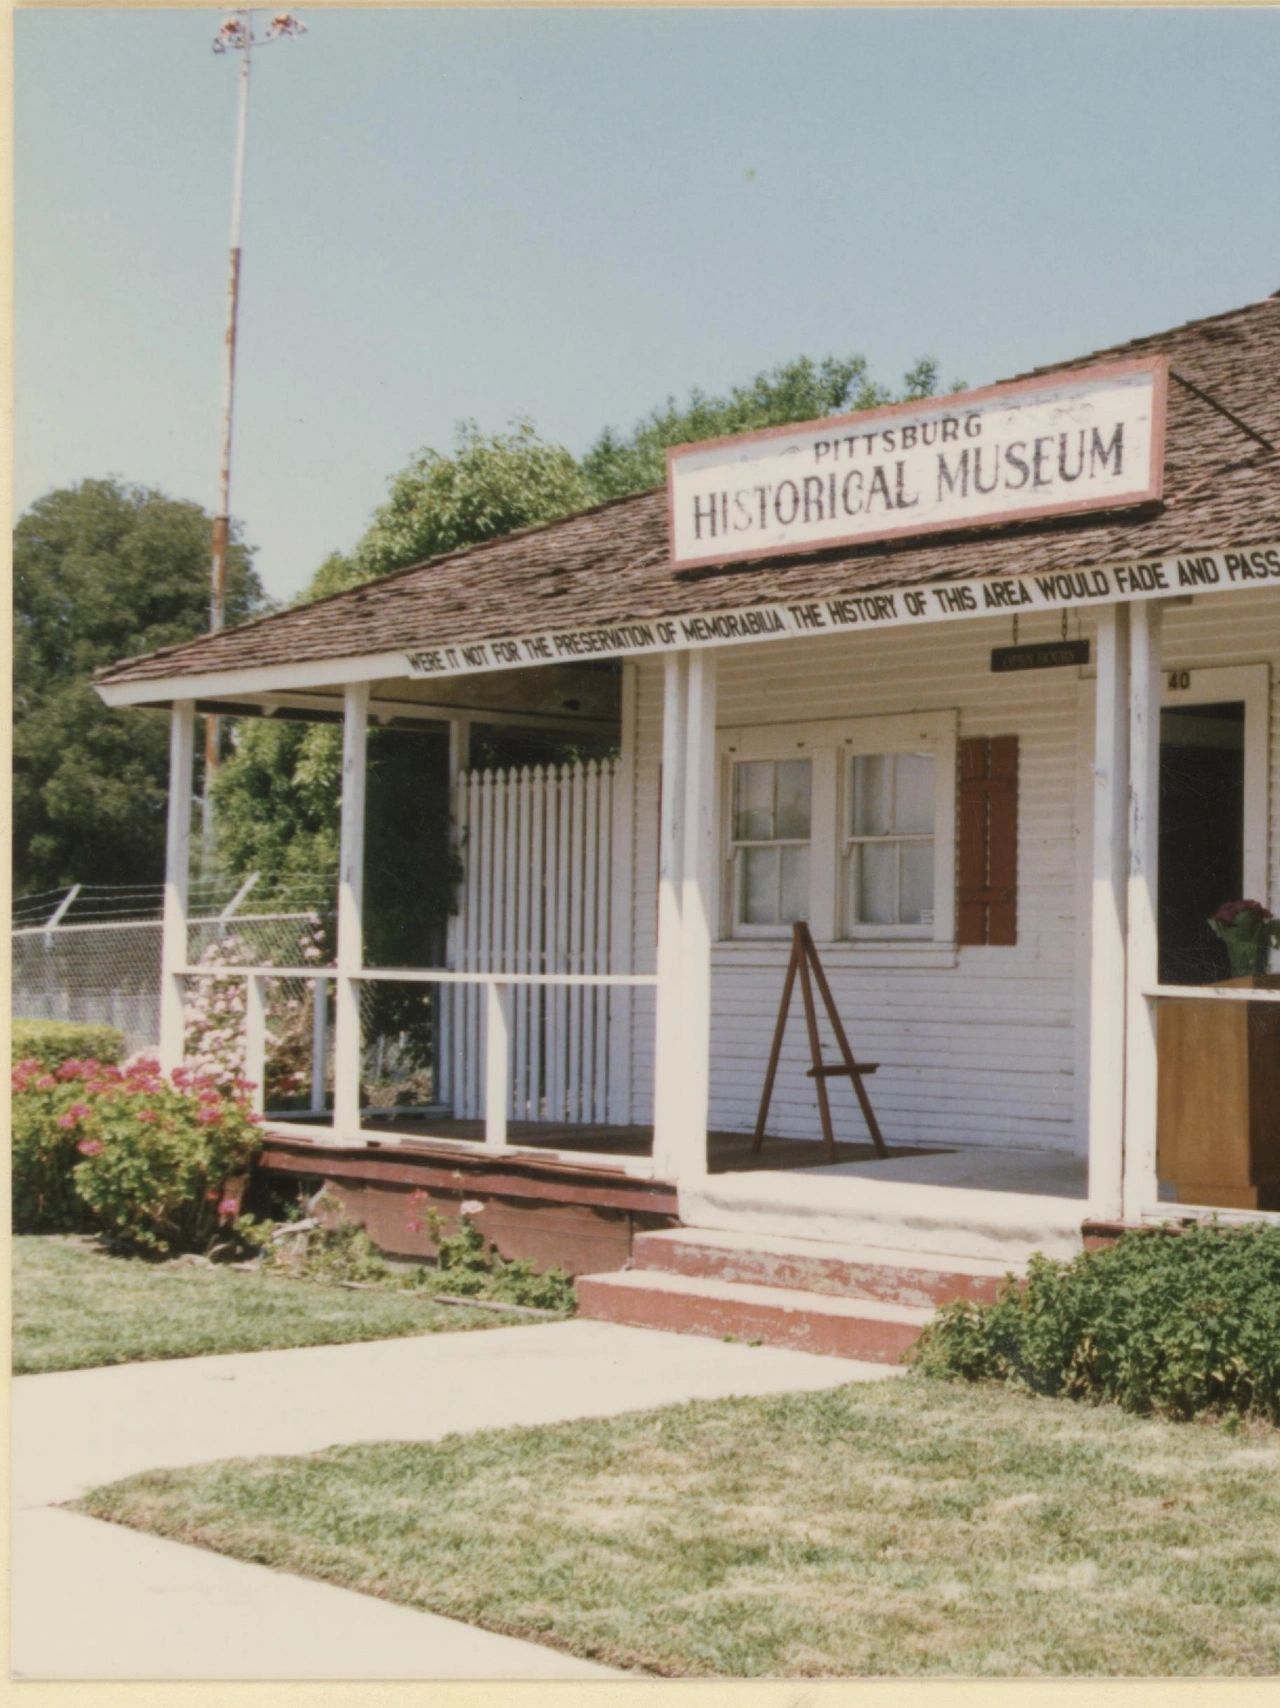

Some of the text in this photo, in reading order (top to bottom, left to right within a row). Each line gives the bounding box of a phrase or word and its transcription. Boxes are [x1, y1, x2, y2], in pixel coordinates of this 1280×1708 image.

[693, 421, 1125, 540] HISTORICAL MUSEUM
[814, 413, 983, 464] PITTSBURG
[405, 652, 444, 673] WERE
[446, 650, 458, 669] IT
[462, 645, 489, 668] NOT
[491, 642, 519, 664] FOR
[520, 637, 553, 660] THE
[553, 625, 654, 656] PRESERVATION
[656, 621, 677, 644] OF
[681, 609, 785, 642] MEMORABILIA
[788, 605, 826, 629] THE
[829, 595, 900, 625] HISTORY
[904, 591, 927, 616] OF
[932, 586, 978, 612] THIS
[980, 579, 1032, 608] AREA
[1035, 570, 1110, 601] WOULD
[1113, 562, 1169, 594] FADE
[1177, 556, 1220, 587] AND
[1167, 671, 1191, 690] 40
